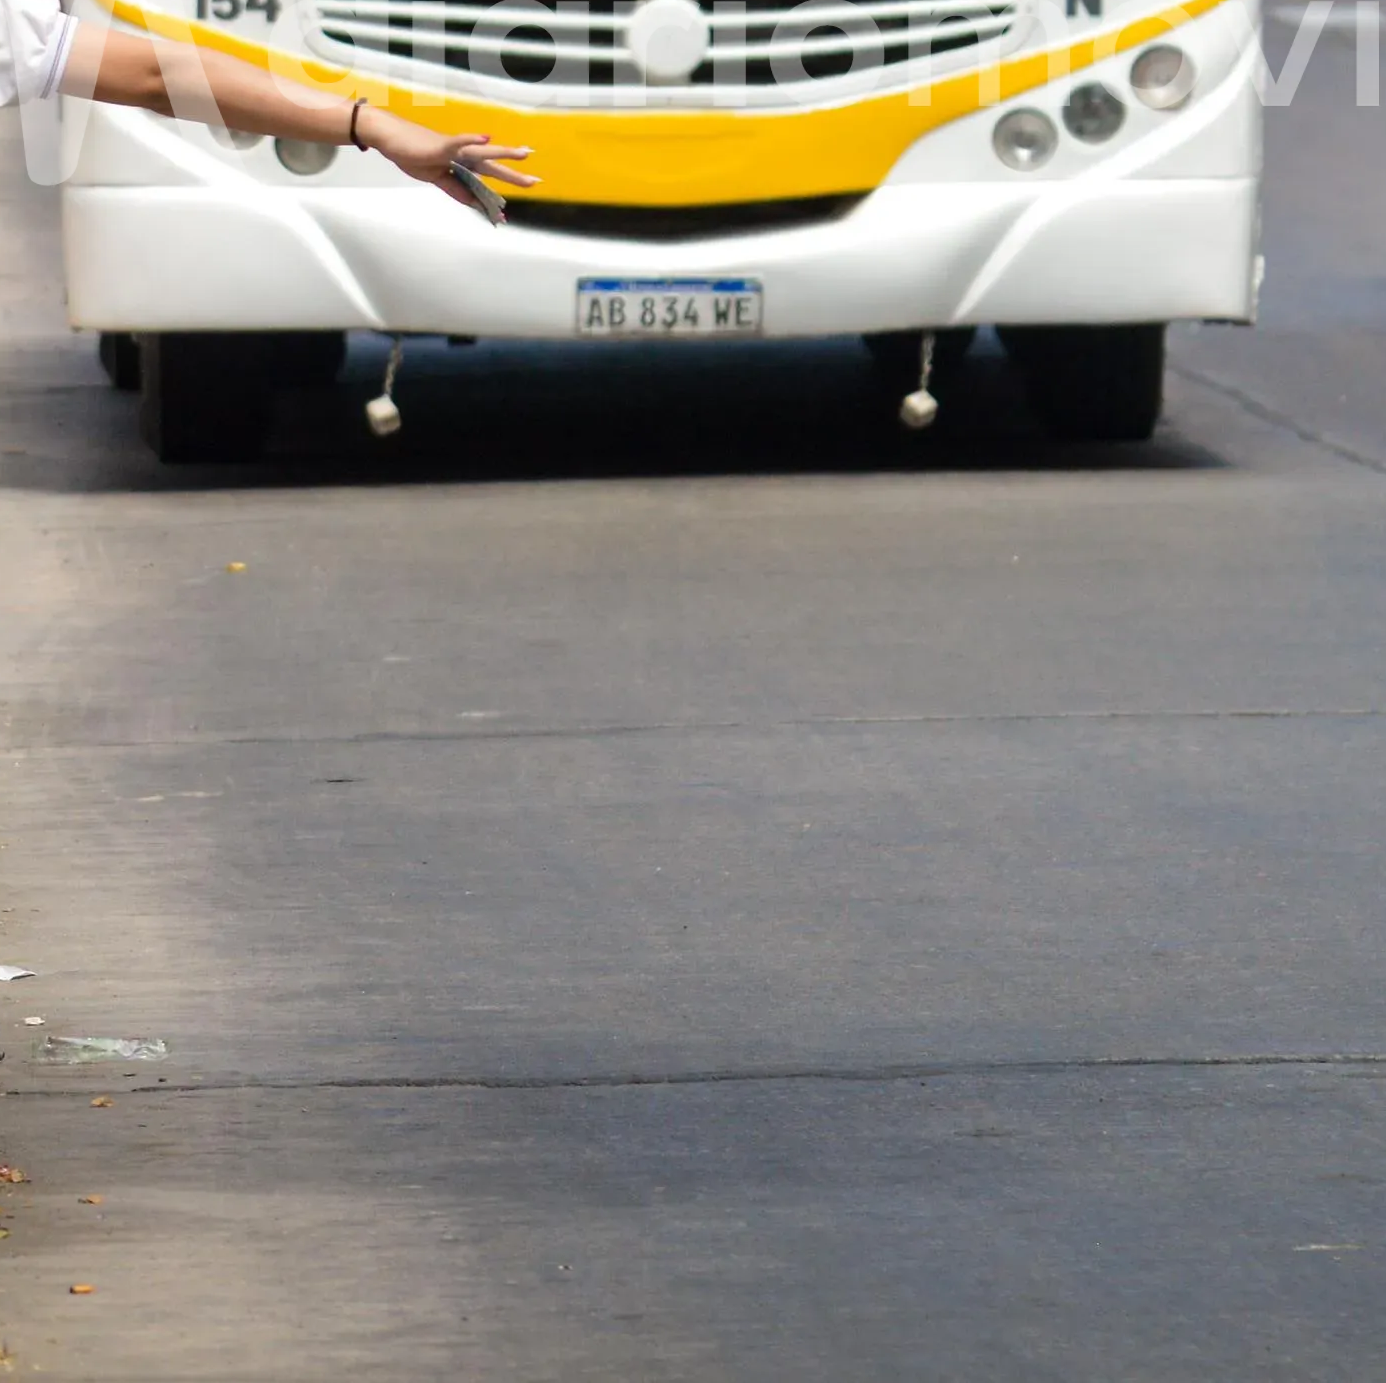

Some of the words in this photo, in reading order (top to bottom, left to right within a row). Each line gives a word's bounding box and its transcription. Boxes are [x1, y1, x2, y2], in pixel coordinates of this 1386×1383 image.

[587, 297, 626, 328] AB
[639, 297, 700, 329] 834
[714, 297, 754, 327] WE
